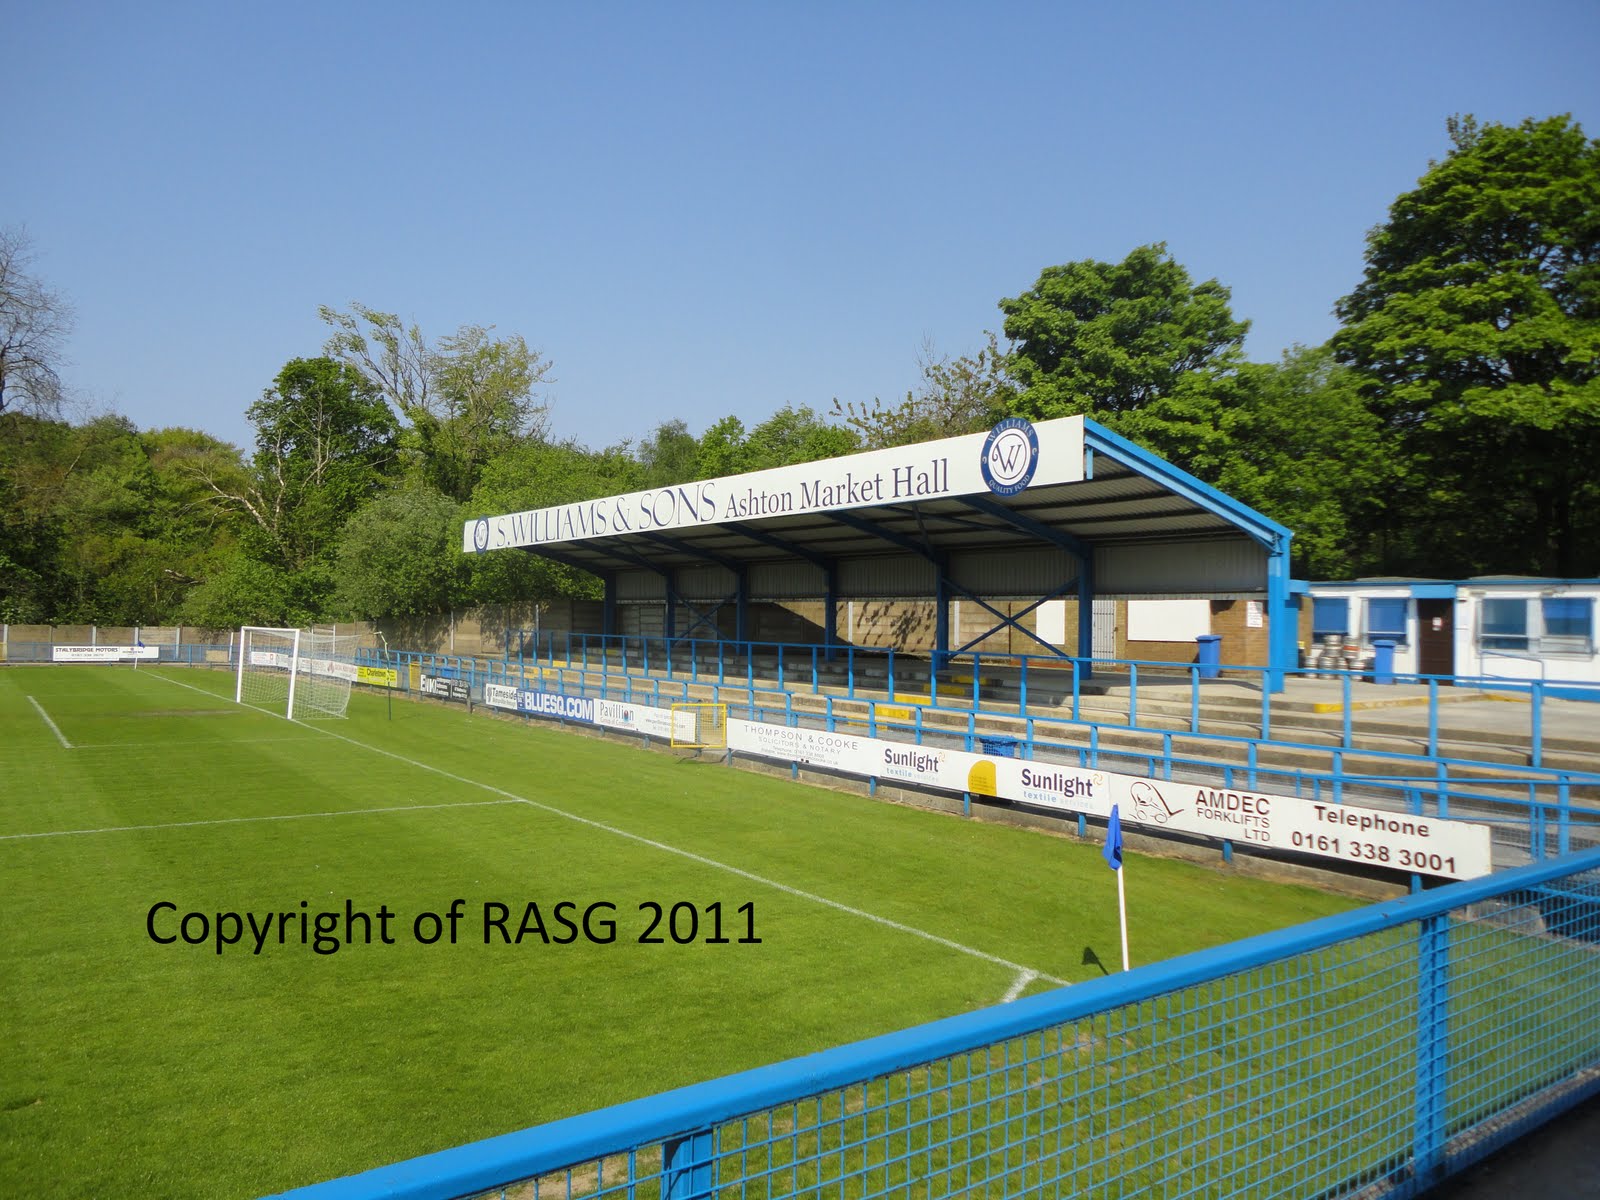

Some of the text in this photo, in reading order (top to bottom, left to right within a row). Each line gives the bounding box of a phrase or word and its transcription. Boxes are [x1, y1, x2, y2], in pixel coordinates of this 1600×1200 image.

[988, 419, 1034, 441] WILLIAMS
[612, 496, 633, 532] &
[639, 482, 716, 530] SONS
[724, 486, 793, 519] Ashton
[800, 472, 884, 510] Market
[892, 458, 950, 498] Hall
[989, 474, 1030, 493] QUALITY FOOD
[492, 687, 517, 701] Tameside
[524, 691, 593, 721] BLUESQ.COM
[600, 701, 634, 723] Pavillion
[744, 725, 858, 750] THOMPSON & COOKE
[758, 736, 800, 749] SOLICITORS
[810, 745, 841, 755] NOTARY
[884, 748, 939, 773] Sunlight
[886, 767, 912, 778] textile
[1021, 768, 1093, 798] Sunlight
[1023, 790, 1057, 803] textile
[1195, 789, 1271, 815] AMDEC
[1197, 806, 1271, 829] FORKLIFTS
[1313, 805, 1430, 838] Telephone
[1244, 828, 1271, 843] LTD
[1291, 830, 1456, 874] 0161 338 3001
